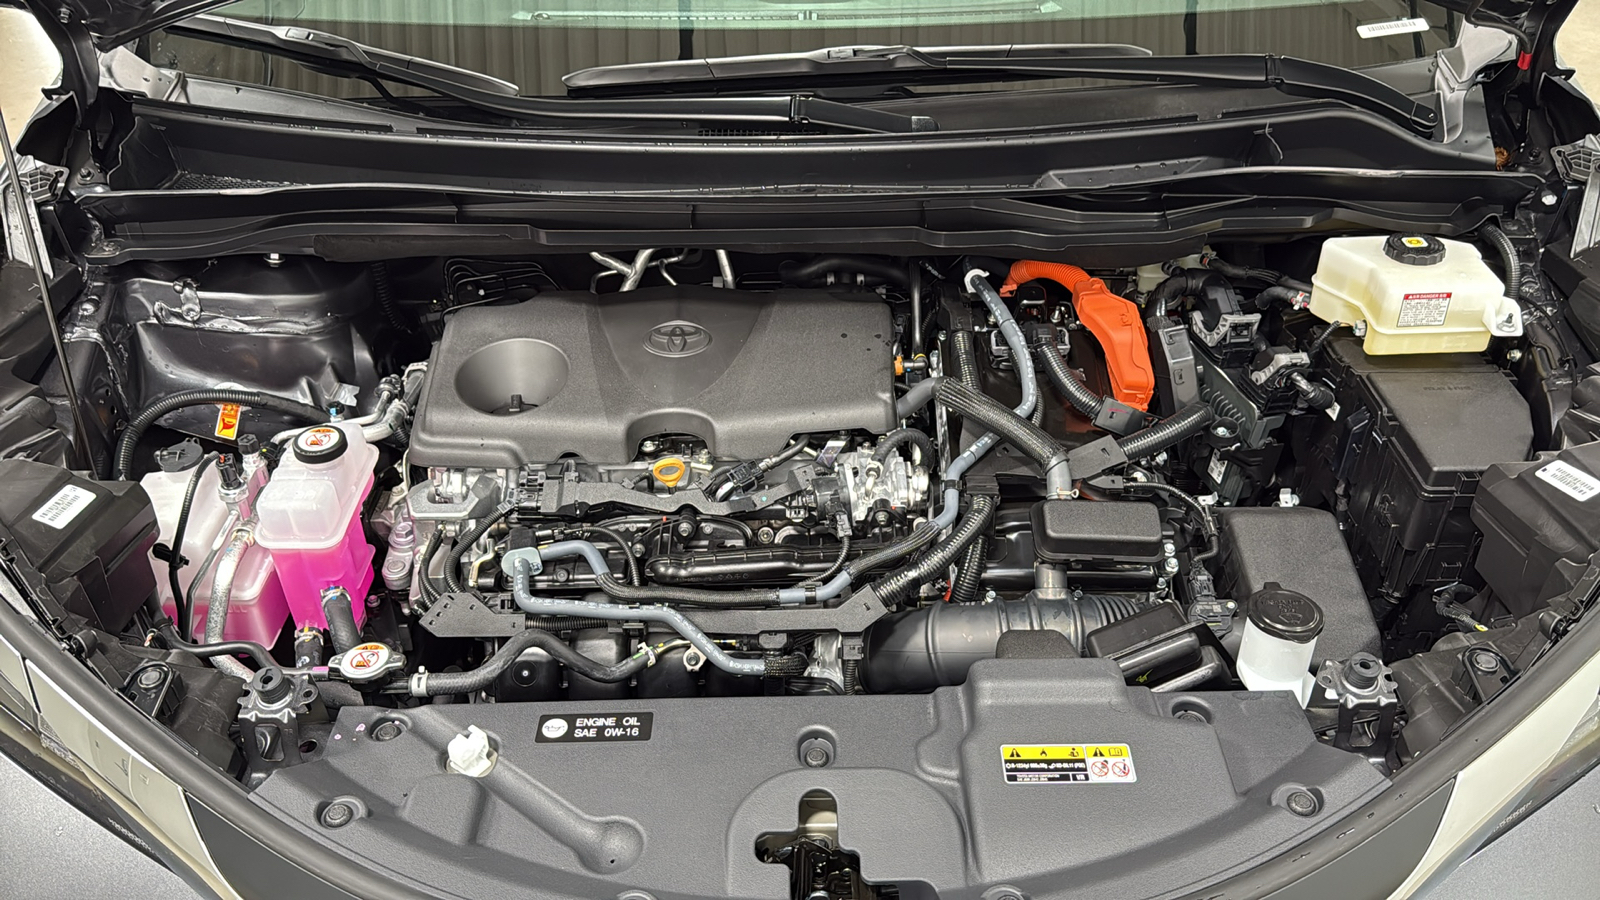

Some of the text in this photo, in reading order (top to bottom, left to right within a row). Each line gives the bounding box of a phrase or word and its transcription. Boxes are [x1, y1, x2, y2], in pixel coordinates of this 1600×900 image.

[575, 716, 641, 727] ENGINE OIL
[573, 727, 640, 738] SAE 0W-16
